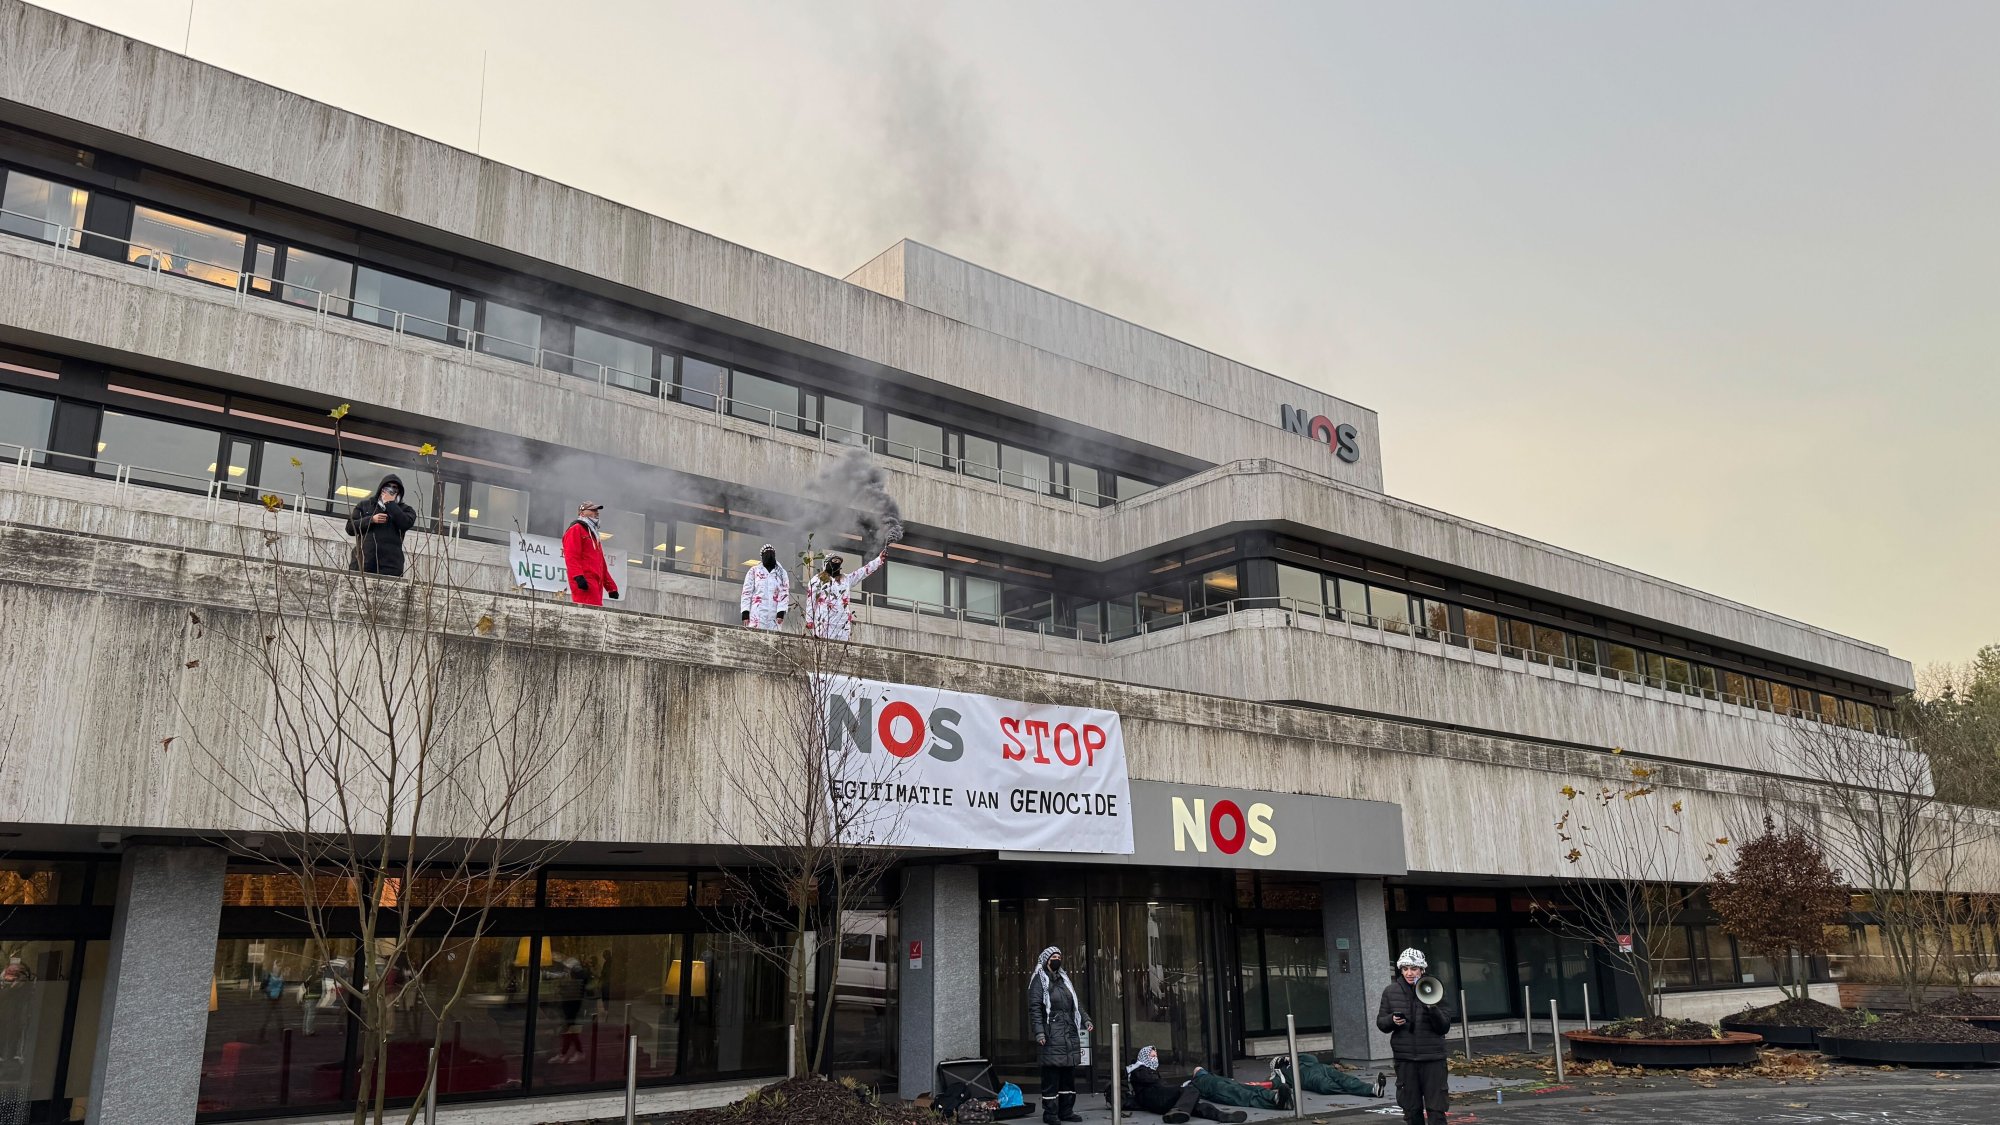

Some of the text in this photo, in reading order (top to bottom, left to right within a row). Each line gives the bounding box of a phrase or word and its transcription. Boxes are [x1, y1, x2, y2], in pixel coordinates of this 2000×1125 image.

[1281, 404, 1359, 463] NOS
[518, 540, 550, 556] TAAL
[827, 693, 1107, 767] NOS STOP
[966, 789, 999, 809] VAN
[1010, 788, 1118, 816] GENOCIDE
[1172, 796, 1277, 857] NOS
